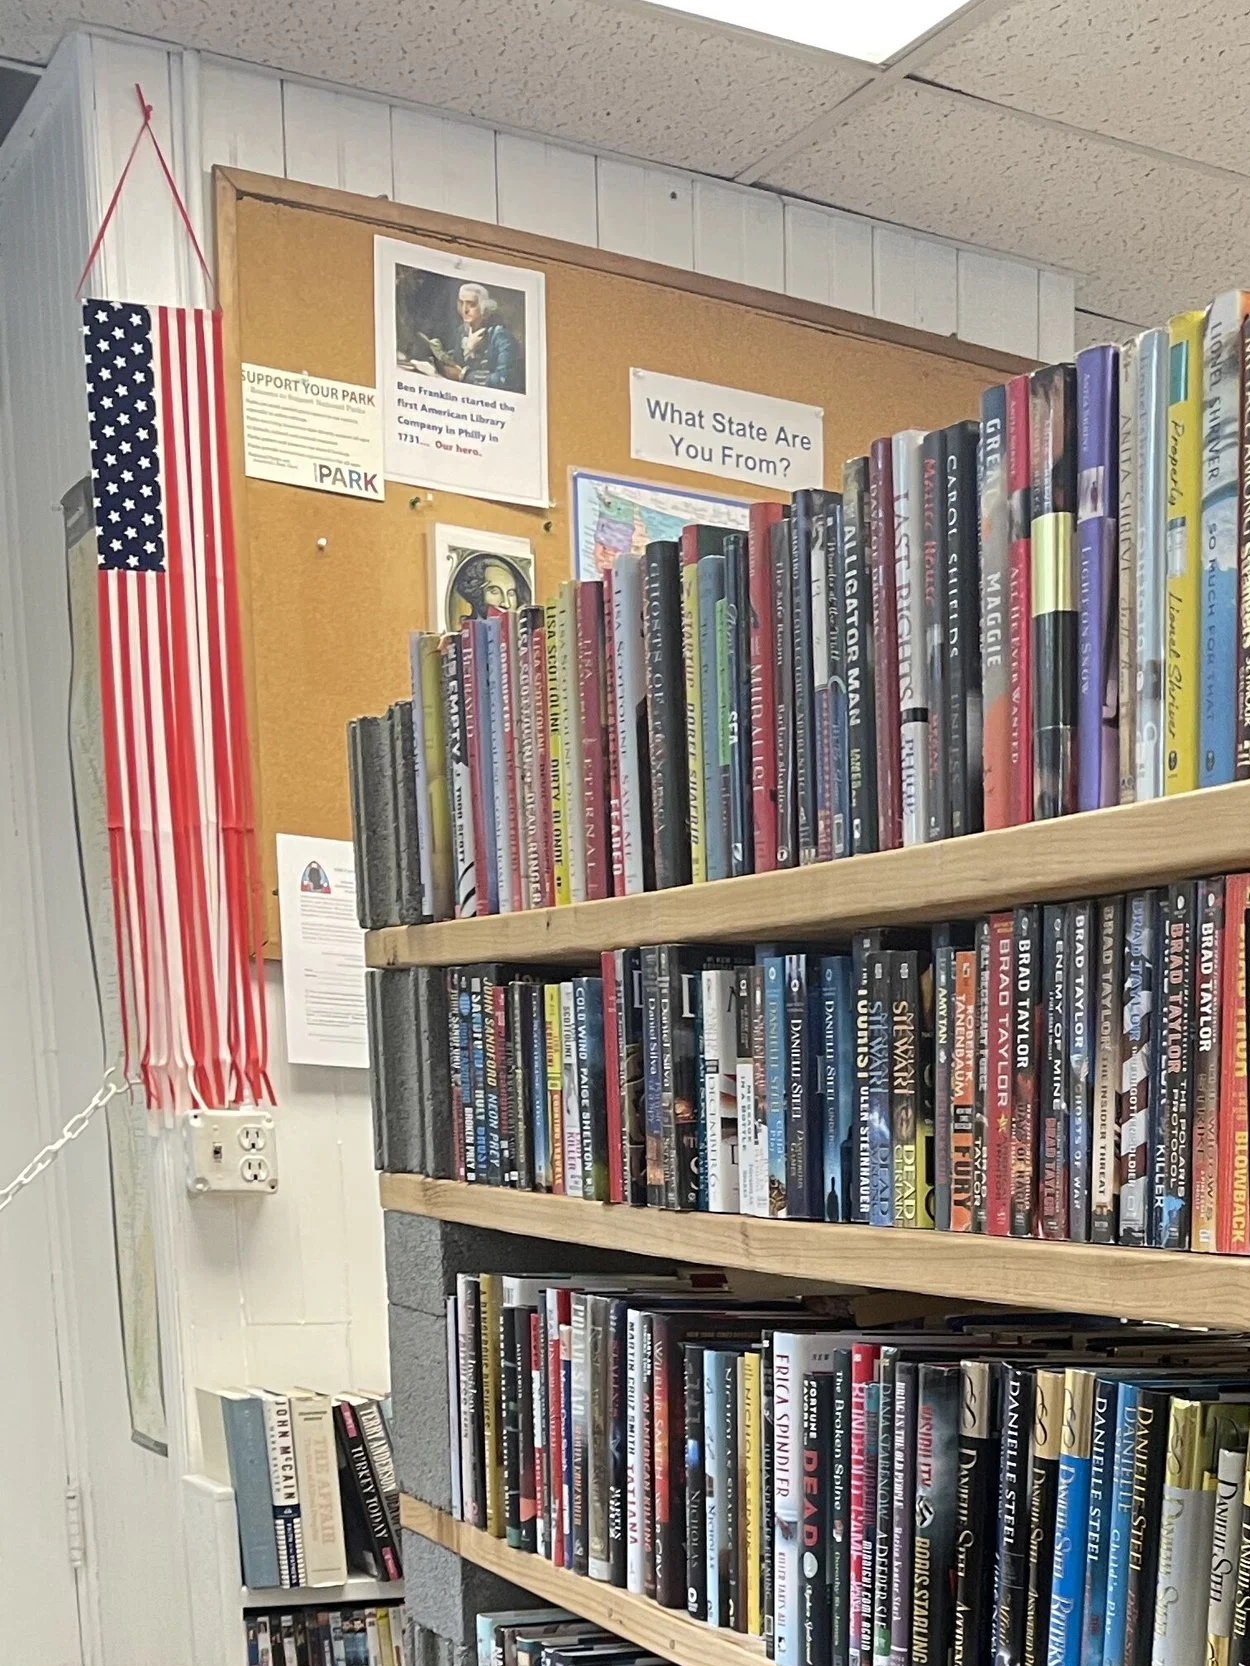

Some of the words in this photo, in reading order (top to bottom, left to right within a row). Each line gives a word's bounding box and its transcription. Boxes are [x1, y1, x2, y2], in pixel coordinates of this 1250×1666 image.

[1206, 321, 1223, 389] LIONEL
[241, 368, 300, 392] SUPPORT
[302, 381, 338, 400] YOUR
[341, 389, 375, 407] PARK
[397, 382, 415, 397] Ben
[419, 385, 457, 402] Franklin
[461, 394, 496, 409] started
[500, 401, 515, 412] the
[397, 398, 418, 411] first
[421, 403, 467, 421] American
[470, 412, 505, 428] Library
[398, 416, 443, 435] Company
[446, 426, 455, 435] in
[459, 428, 486, 442] Philly
[489, 433, 498, 443] in
[435, 440, 453, 451] Our
[456, 443, 481, 457] hero.
[646, 398, 704, 430] What
[711, 409, 768, 442] State
[774, 420, 811, 451] Are
[1206, 396, 1221, 482] SHRIVER
[319, 464, 378, 493] PARK
[669, 433, 713, 466] You
[721, 442, 791, 478] From?
[1166, 419, 1185, 518] Property
[843, 525, 860, 662] ALLIGATOR
[848, 668, 861, 726] MAN
[1018, 939, 1032, 994] BRAD
[1016, 998, 1031, 1069] TAYLOR
[276, 1401, 290, 1438] JOHN
[833, 1400, 845, 1459] Broken
[351, 1445, 375, 1494] TURKEY
[366, 1498, 389, 1540] TODAY
[801, 1449, 819, 1548] DEAD
[833, 1463, 844, 1512] Spine
